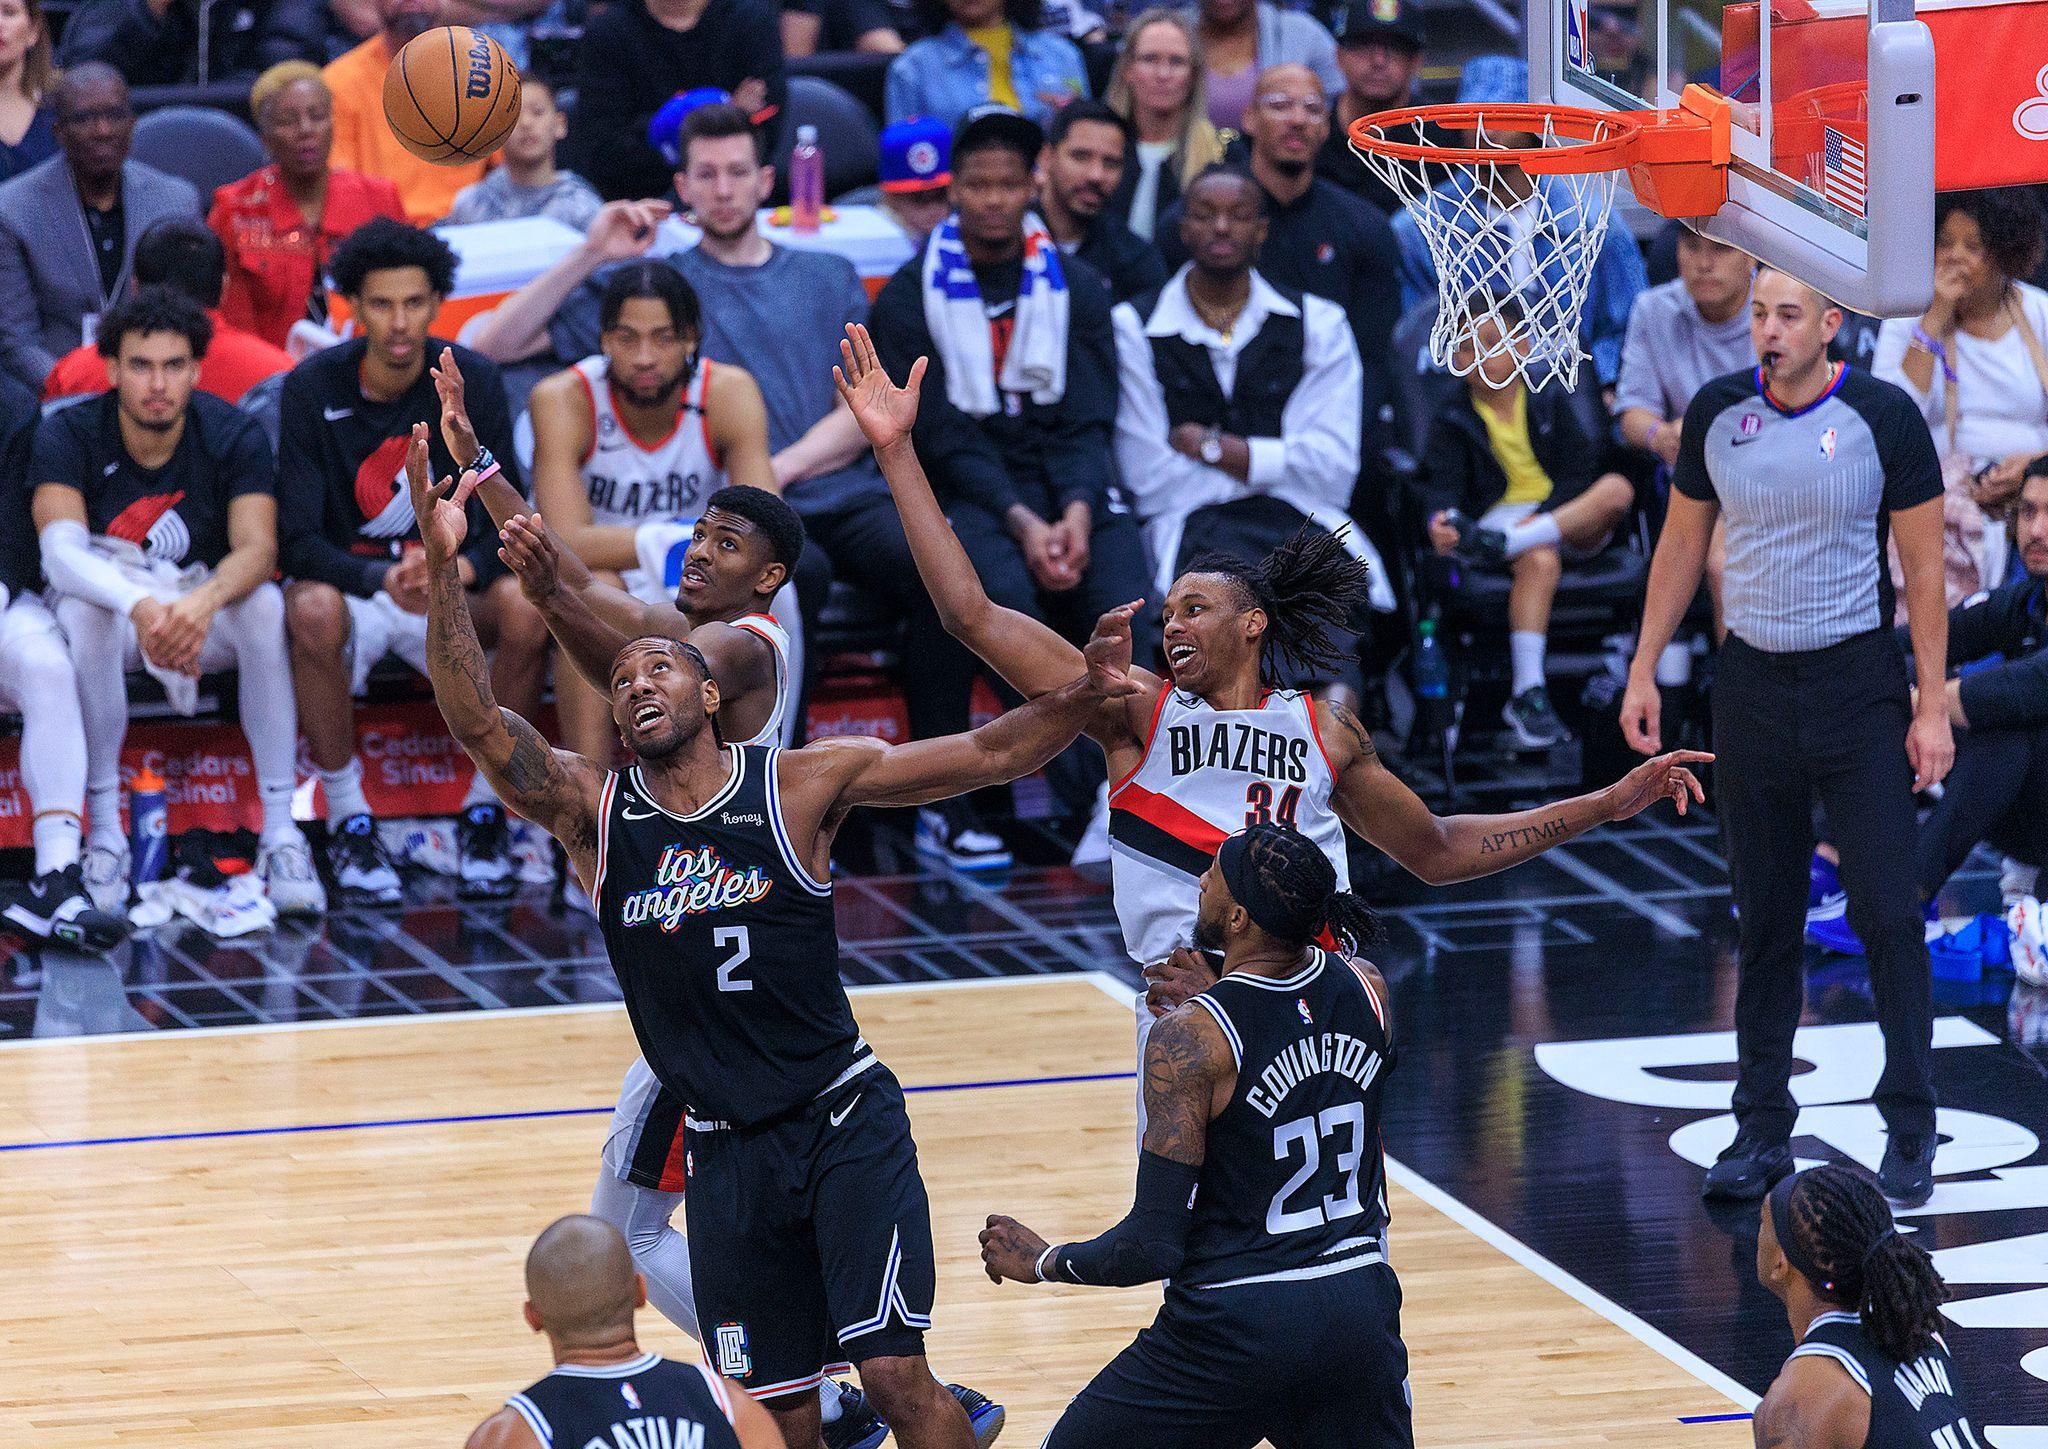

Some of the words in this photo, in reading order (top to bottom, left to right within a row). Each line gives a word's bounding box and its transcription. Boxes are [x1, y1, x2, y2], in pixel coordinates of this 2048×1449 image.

[380, 759, 457, 785] Sinai
[1167, 723, 1309, 783] BLAZERS
[720, 811, 764, 827] honey
[1245, 780, 1303, 831] 34
[656, 846, 721, 887] los
[623, 867, 770, 930] angeles
[713, 925, 753, 992] 2
[1246, 1032, 1383, 1119] COVINGTON
[1265, 1101, 1365, 1235] 23
[582, 1415, 705, 1449] ATUM
